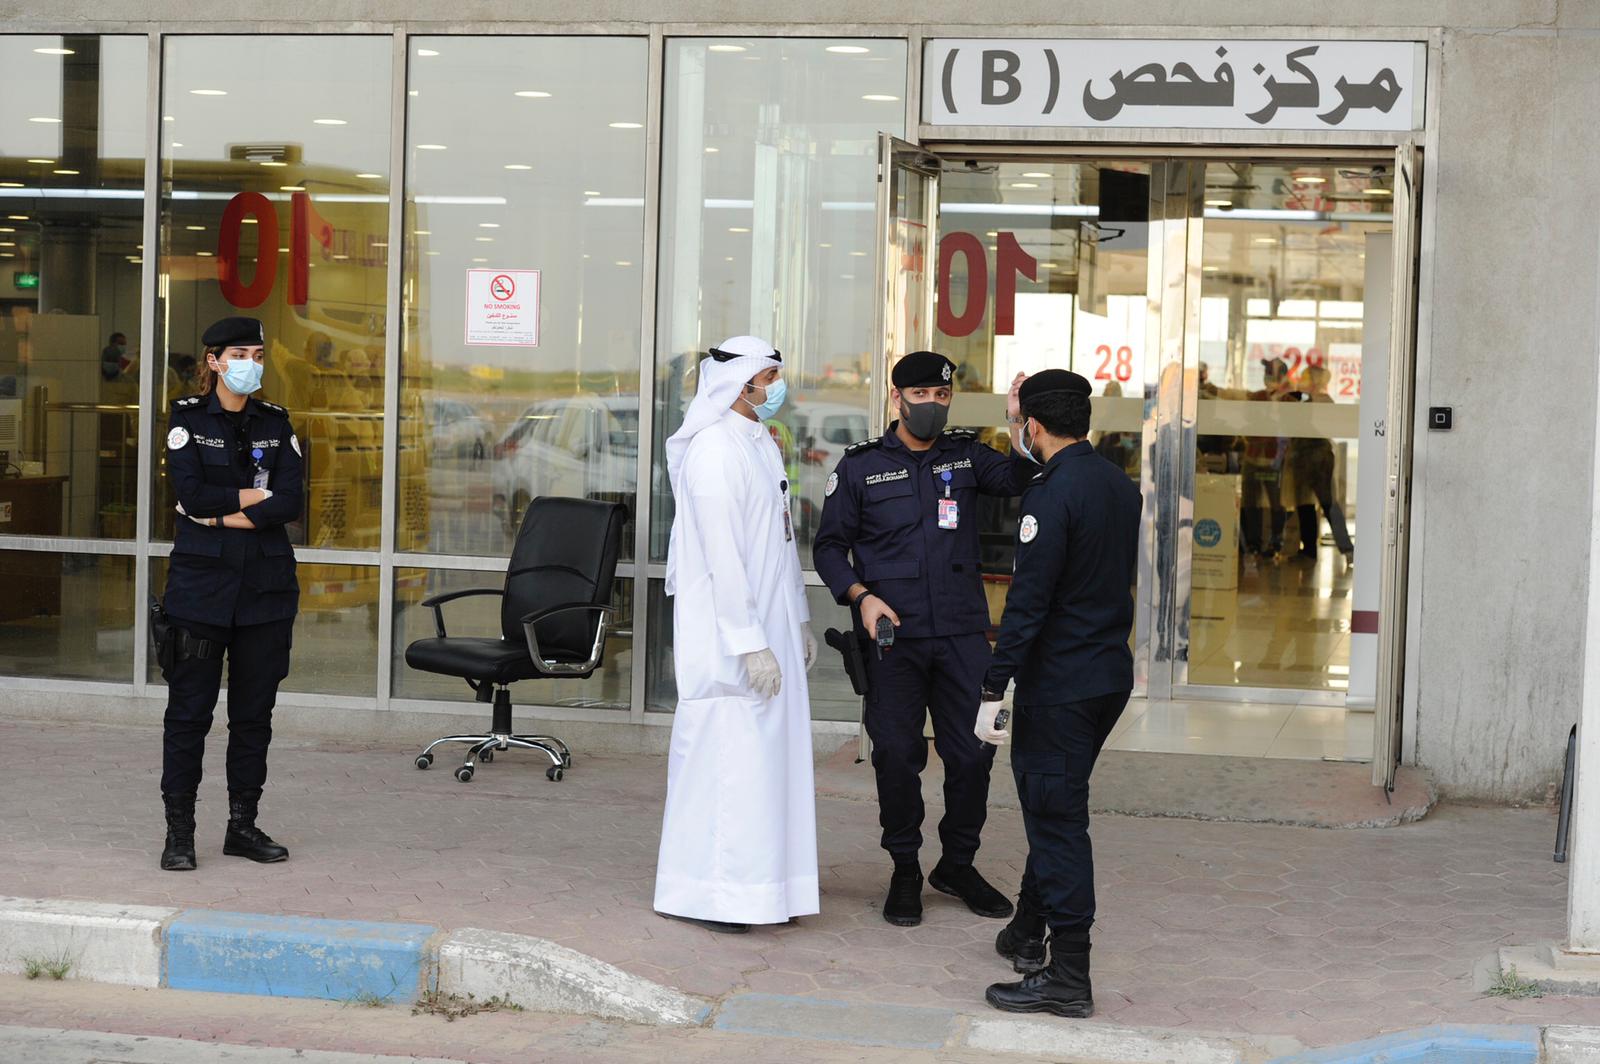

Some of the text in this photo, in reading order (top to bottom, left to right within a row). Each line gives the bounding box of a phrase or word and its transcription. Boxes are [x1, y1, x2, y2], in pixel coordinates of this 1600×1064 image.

[1083, 46, 1234, 121] فحص
[1245, 46, 1402, 125] مركز
[1095, 344, 1132, 382] 28
